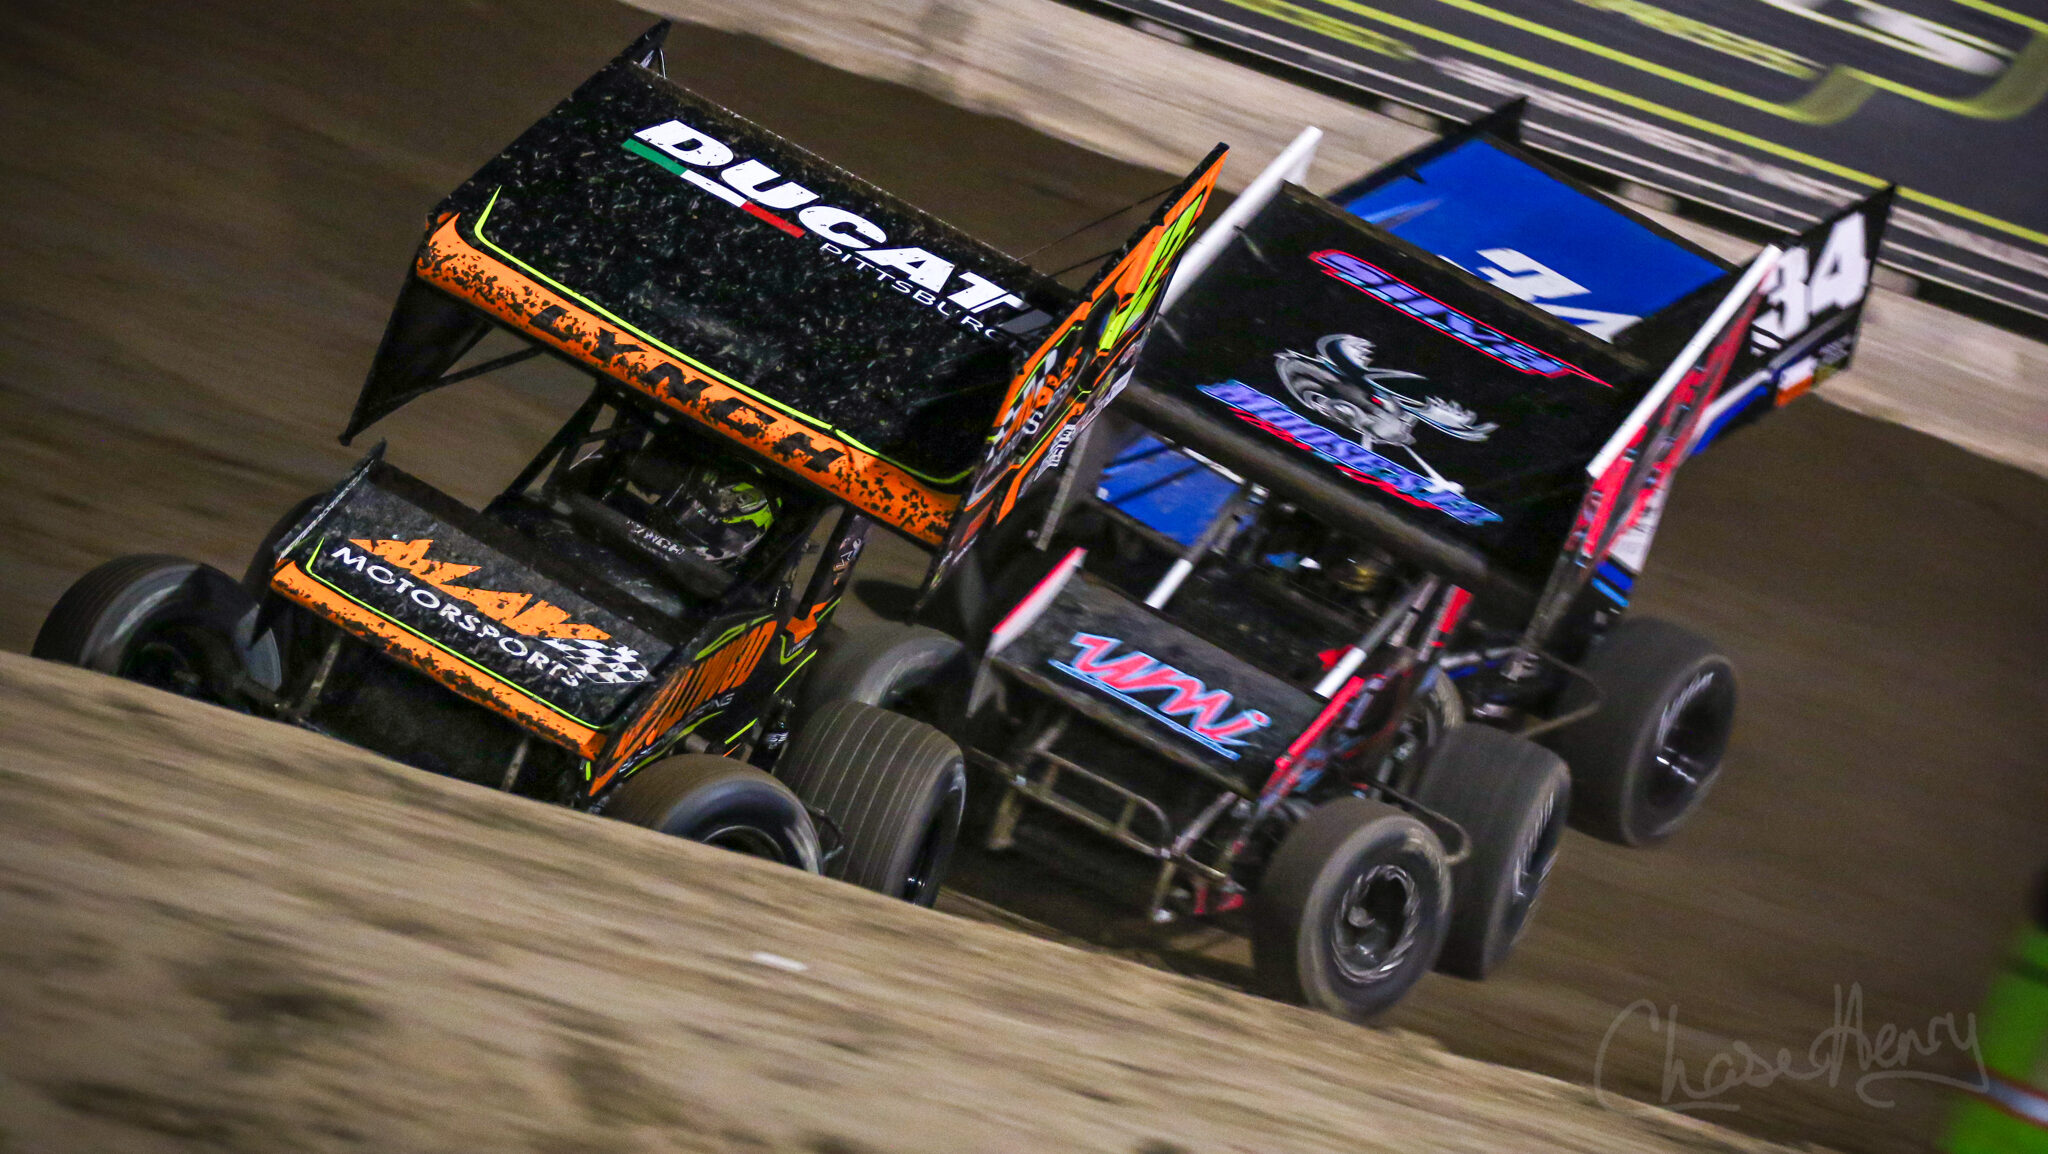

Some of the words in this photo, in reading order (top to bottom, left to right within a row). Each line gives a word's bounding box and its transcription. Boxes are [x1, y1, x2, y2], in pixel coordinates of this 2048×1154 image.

[634, 119, 1054, 336] DUCATI
[1750, 212, 1870, 357] 34
[529, 304, 848, 473] LYNCH
[331, 546, 584, 688] MOTORSPORTS
